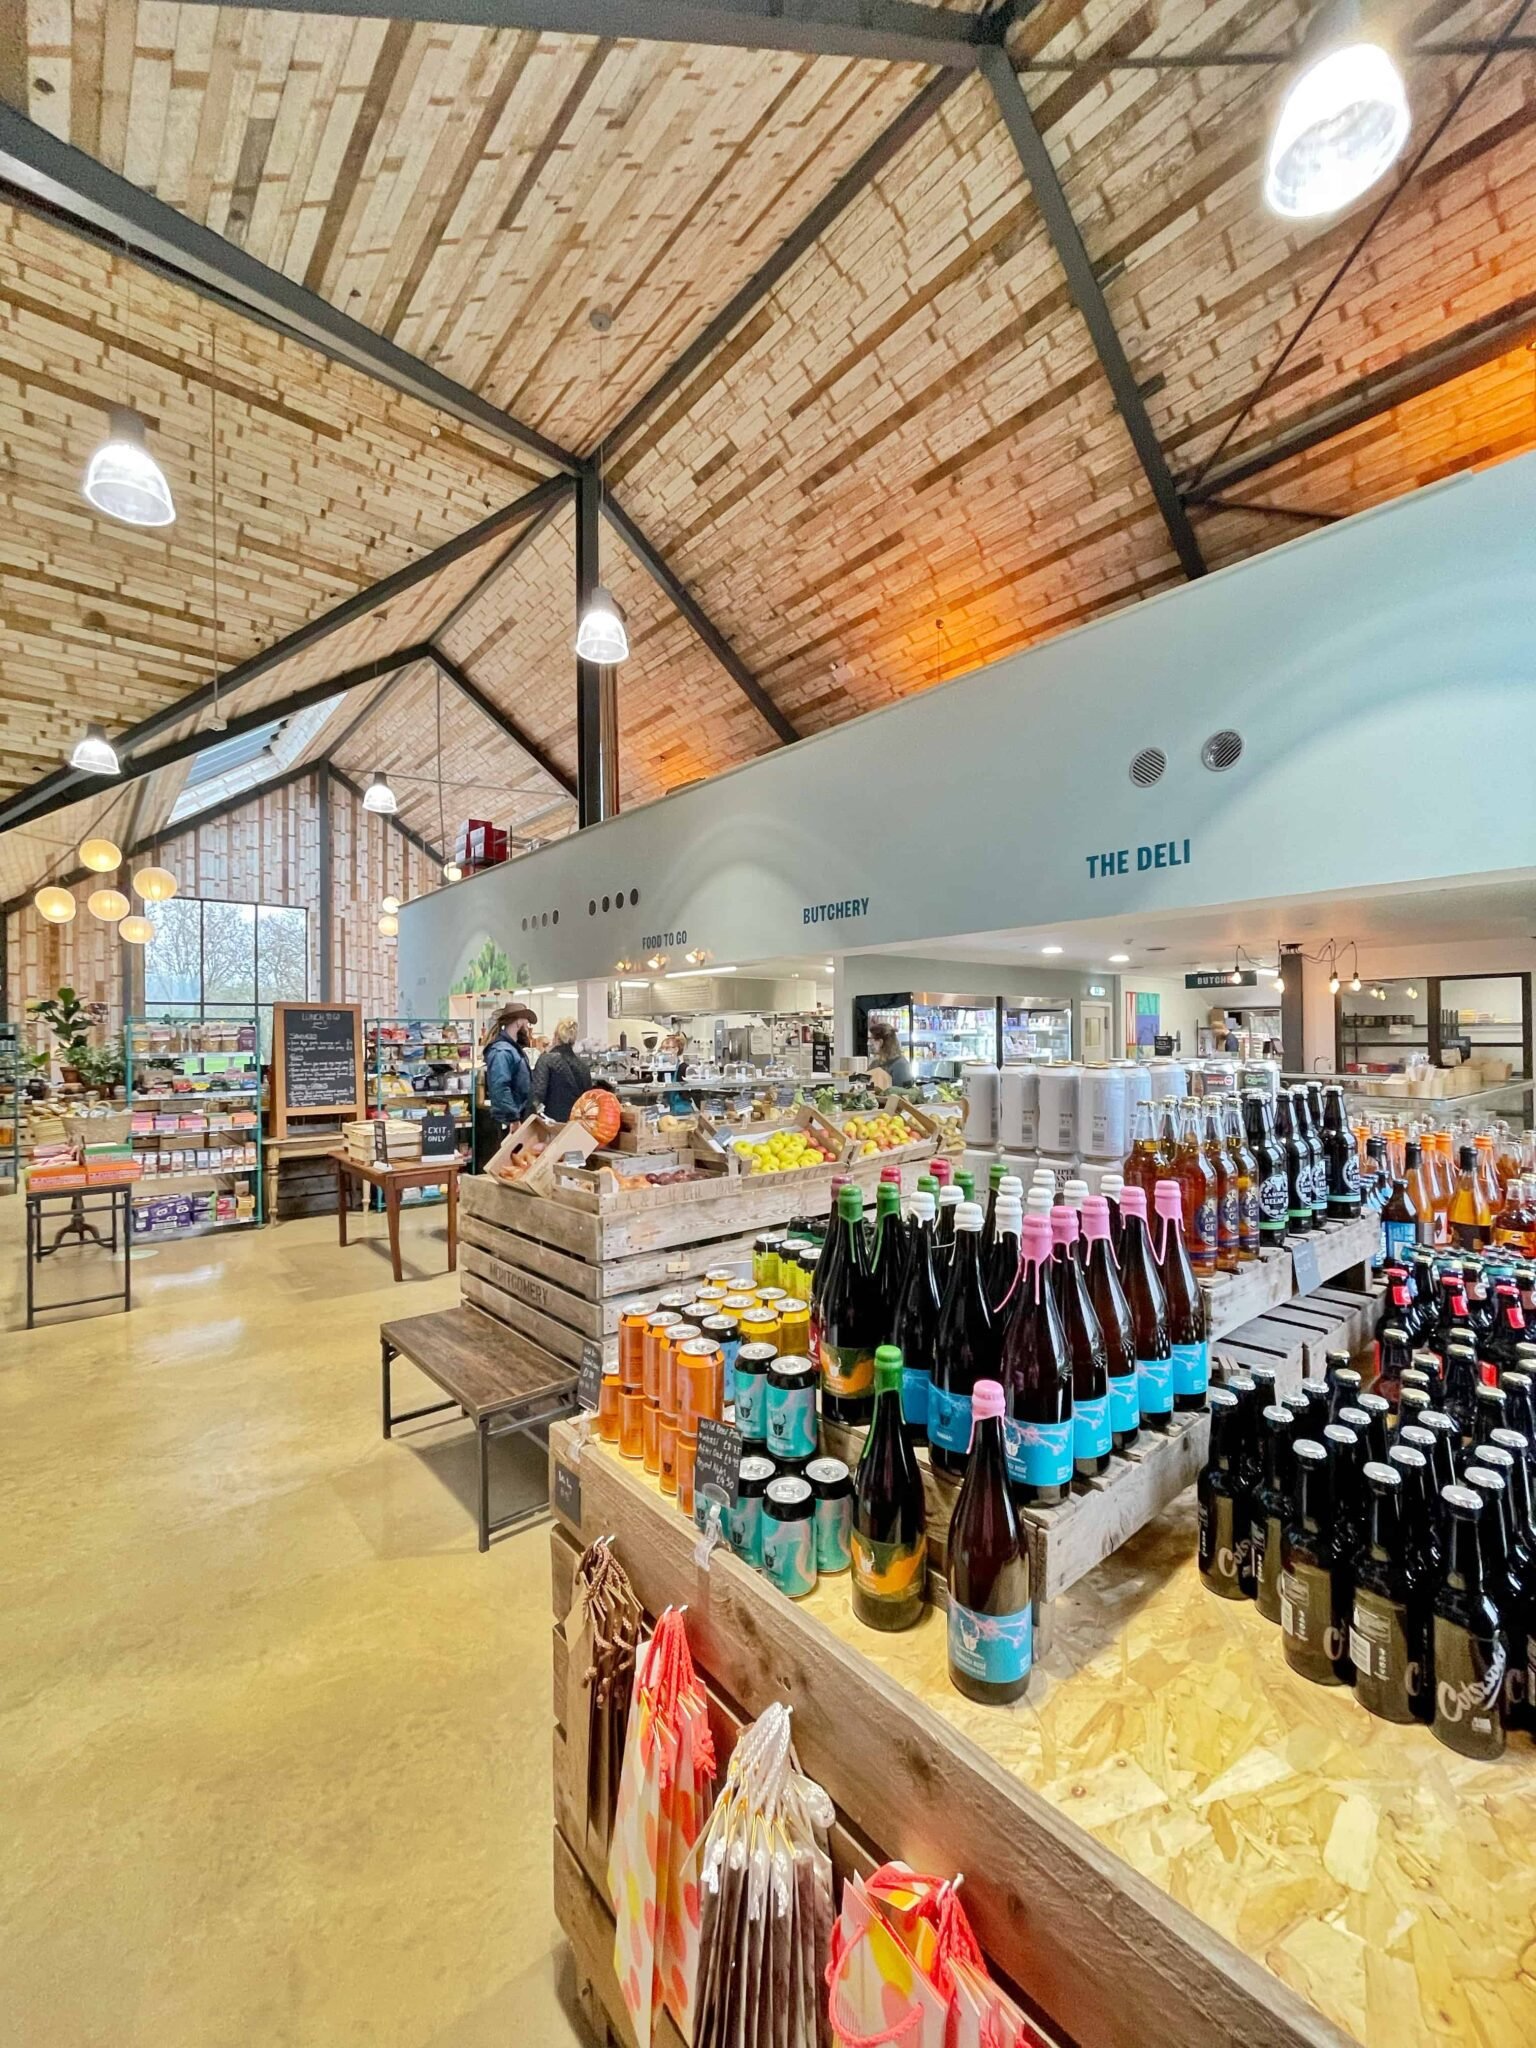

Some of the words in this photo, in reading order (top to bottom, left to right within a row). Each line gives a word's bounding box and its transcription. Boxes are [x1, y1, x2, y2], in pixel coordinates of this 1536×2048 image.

[1086, 850, 1129, 879] THE
[1137, 838, 1191, 871] DELI
[803, 897, 870, 925] BUTCHERY
[642, 934, 662, 950] FOOD
[664, 932, 674, 947] TO
[676, 930, 688, 945] GO
[1197, 975, 1243, 985] BUTCHE
[427, 1126, 447, 1135] EXIT
[427, 1135, 447, 1143] ONLY
